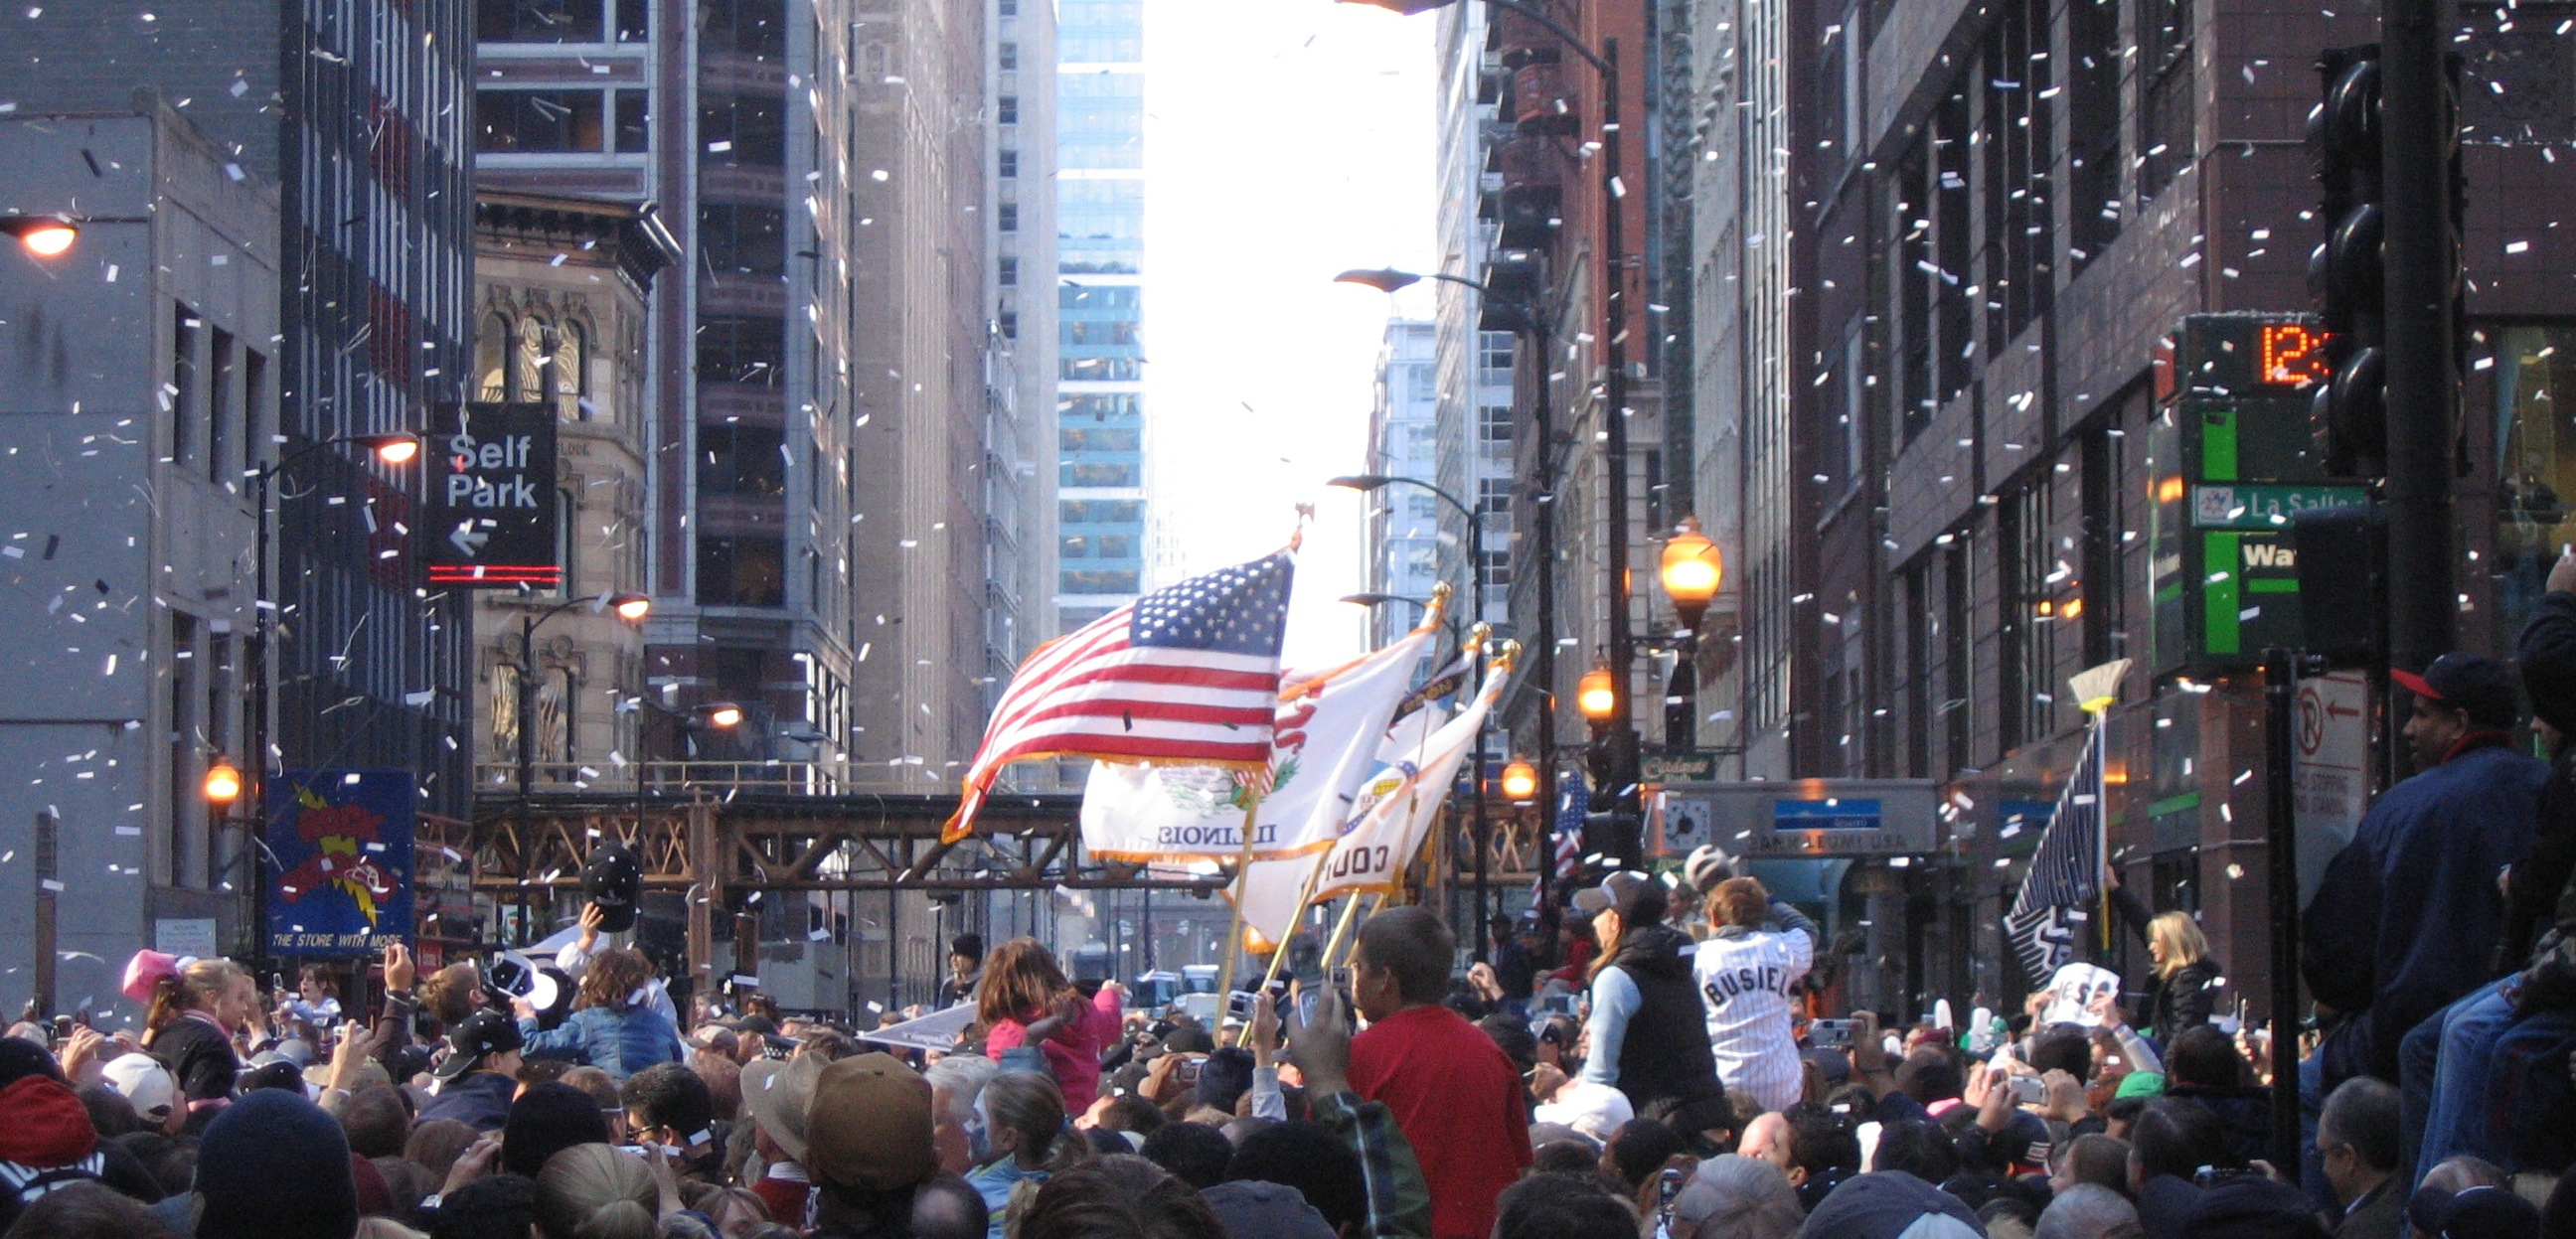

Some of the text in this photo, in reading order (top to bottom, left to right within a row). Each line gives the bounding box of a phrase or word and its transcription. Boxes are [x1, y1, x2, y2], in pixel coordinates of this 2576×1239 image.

[2262, 326, 2330, 383] 12:
[450, 434, 532, 469] Self
[447, 474, 538, 508] Park
[2252, 493, 2282, 517] La
[2243, 544, 2297, 566] Wa
[1871, 834, 1906, 850] USA
[273, 934, 402, 947] THE STORE WITH MORE
